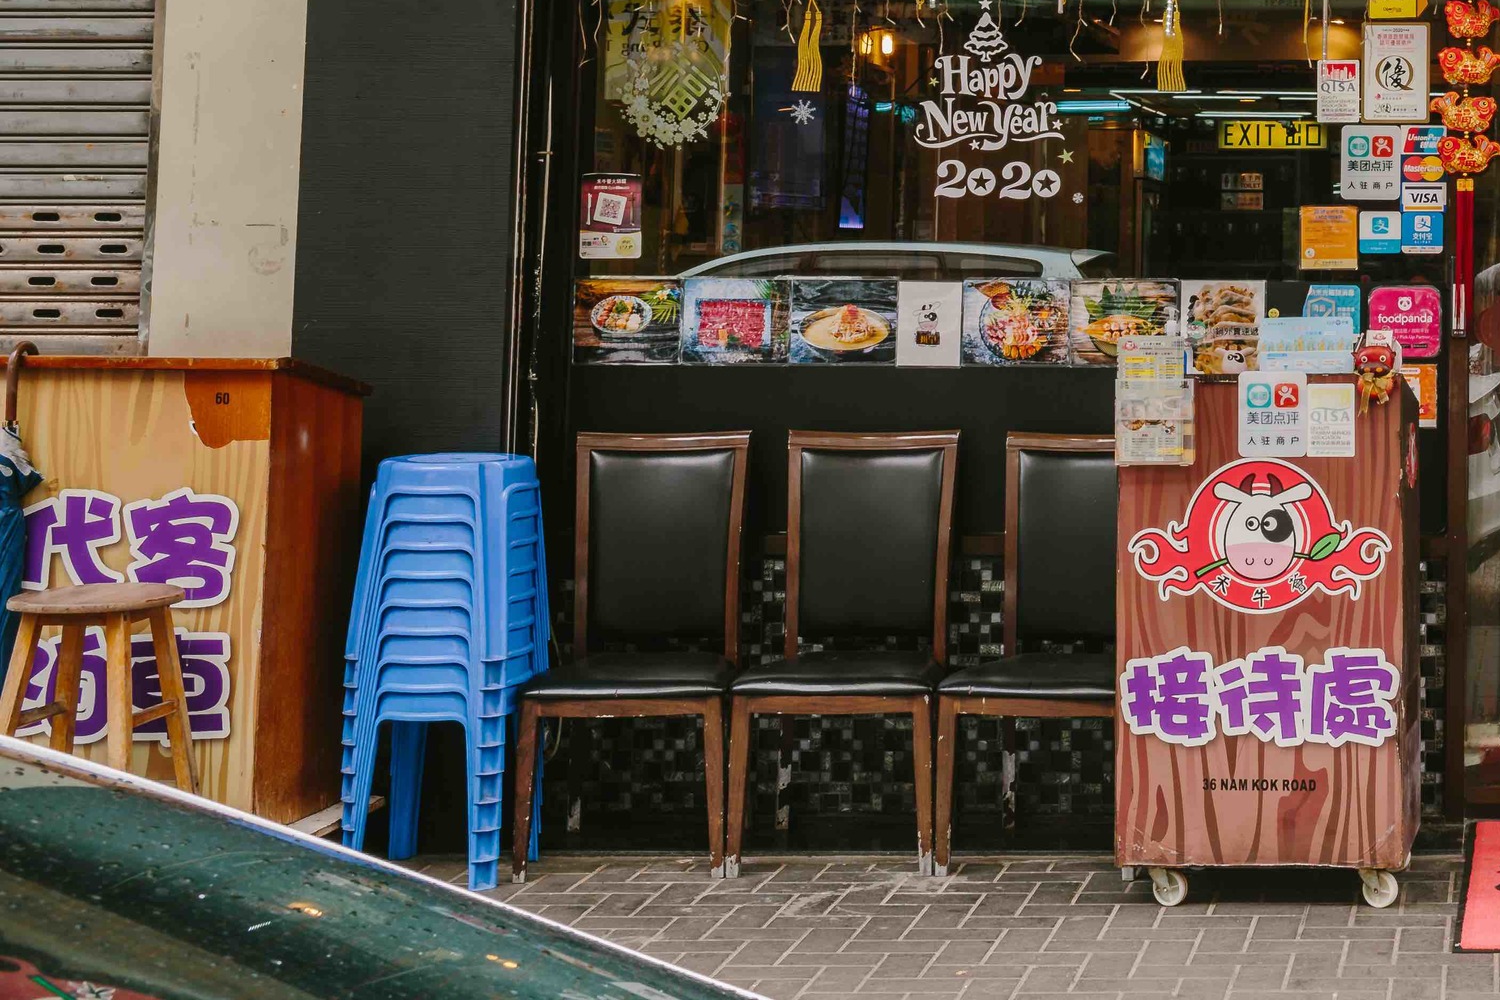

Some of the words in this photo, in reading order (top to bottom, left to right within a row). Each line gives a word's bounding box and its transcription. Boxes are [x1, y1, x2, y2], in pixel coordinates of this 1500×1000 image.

[935, 54, 1042, 99] Happy
[1320, 80, 1356, 93] QTSA
[918, 98, 990, 142] New
[983, 100, 1058, 150] Year
[1224, 124, 1276, 146] EXIT
[1347, 160, 1393, 172] 美团点评
[934, 159, 1061, 199] 2020
[1410, 193, 1438, 203] VISA
[1412, 232, 1432, 240] 支付宝
[1377, 313, 1433, 325] foodpanda
[215, 392, 230, 405] 60
[1247, 411, 1299, 425] 美团点评
[1310, 408, 1350, 424] QTSA
[1247, 436, 1299, 445] 入驻商户
[1125, 651, 1396, 741] 接待處
[1203, 778, 1217, 792] 36
[1220, 778, 1248, 792] NAM
[1252, 778, 1279, 792] KOK
[1282, 778, 1317, 792] ROAD
